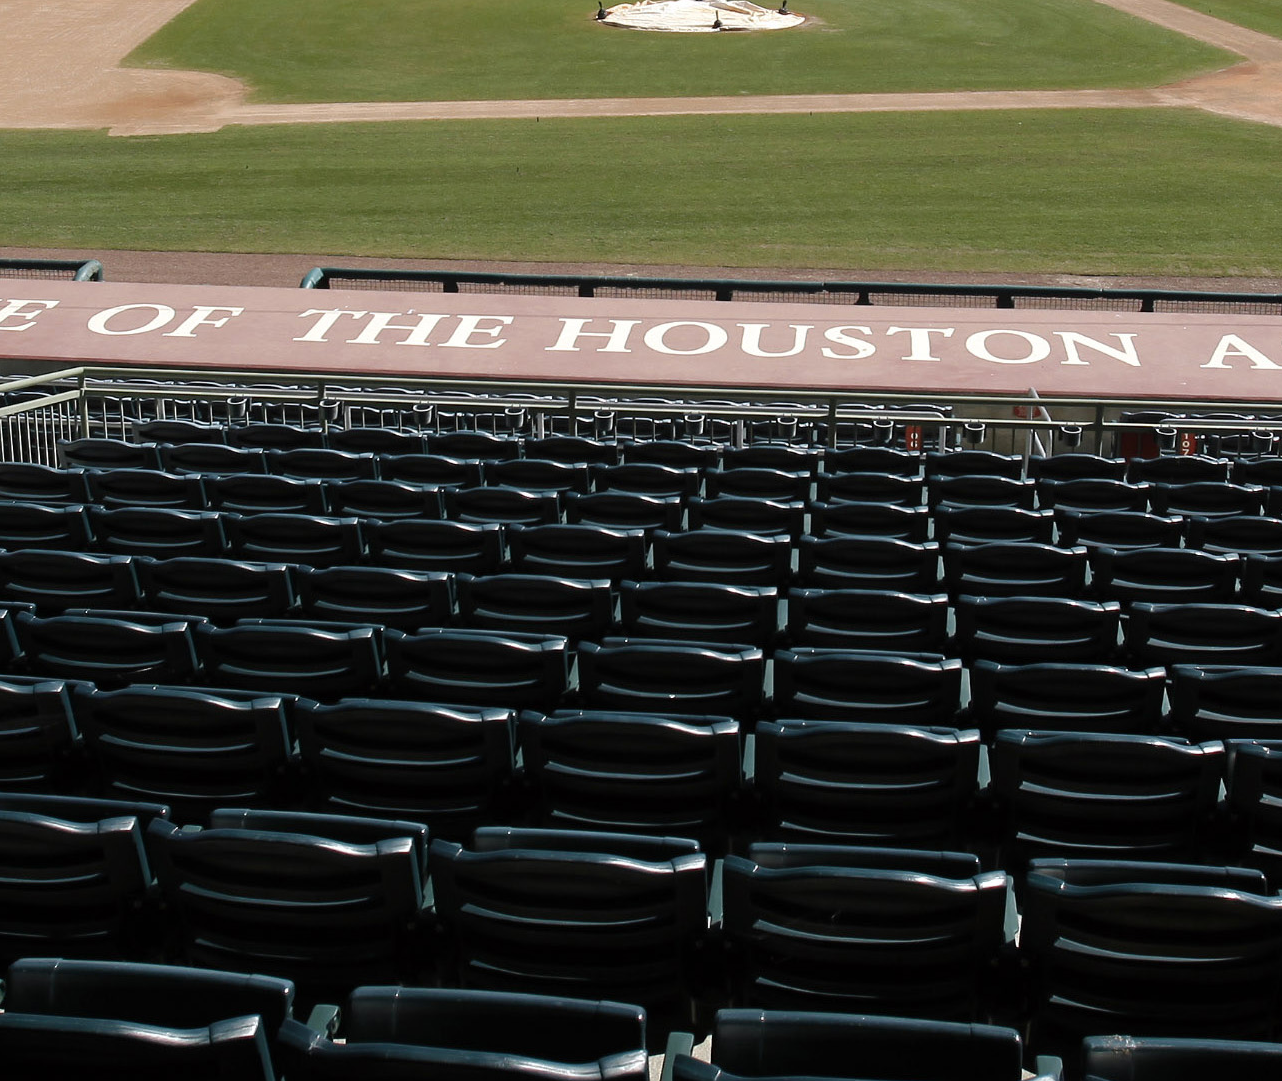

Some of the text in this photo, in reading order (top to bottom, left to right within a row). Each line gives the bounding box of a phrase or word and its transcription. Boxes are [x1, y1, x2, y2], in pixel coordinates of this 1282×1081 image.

[86, 303, 245, 337] OF
[292, 307, 515, 349] THE
[544, 317, 1143, 368] HOUSTON
[1182, 433, 1190, 456] 107
